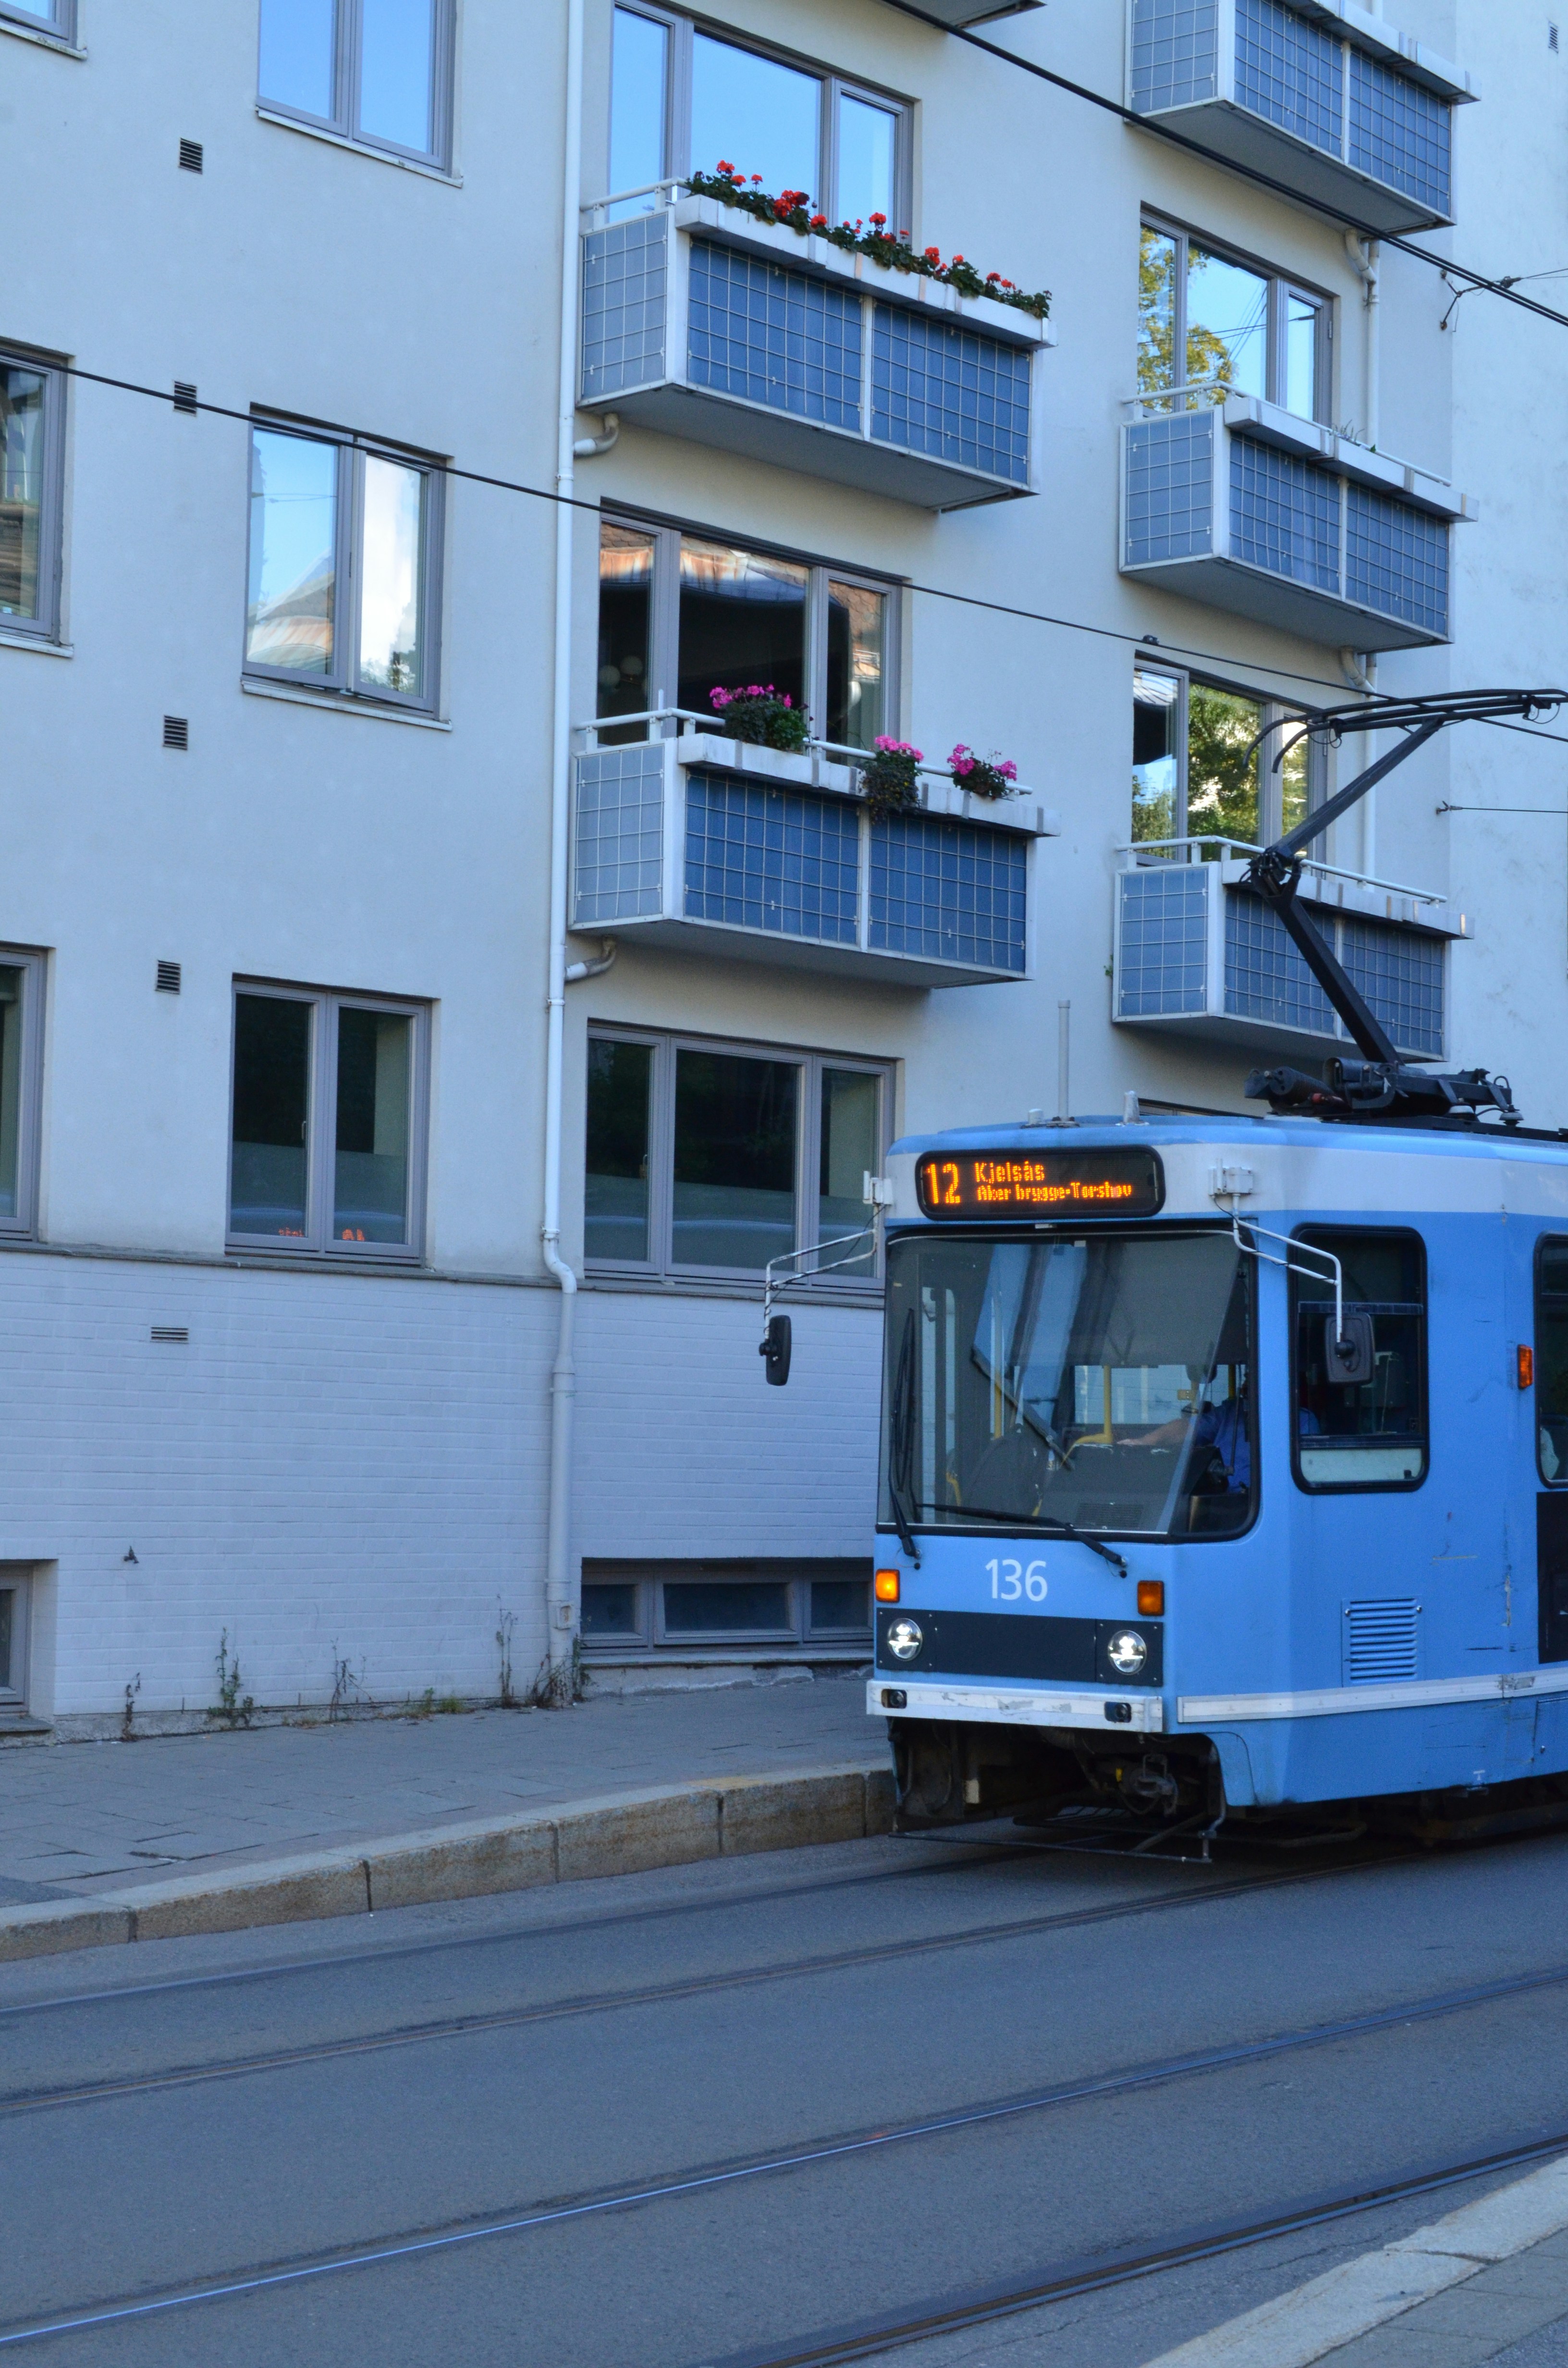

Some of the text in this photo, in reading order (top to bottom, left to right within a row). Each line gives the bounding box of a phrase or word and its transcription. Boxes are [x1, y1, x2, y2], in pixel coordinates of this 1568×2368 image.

[926, 1163, 961, 1204] 12
[974, 1160, 1045, 1184] Kjelsås
[977, 1181, 1132, 1202] Aker brygge-Torshov
[985, 1558, 1048, 1602] 136
